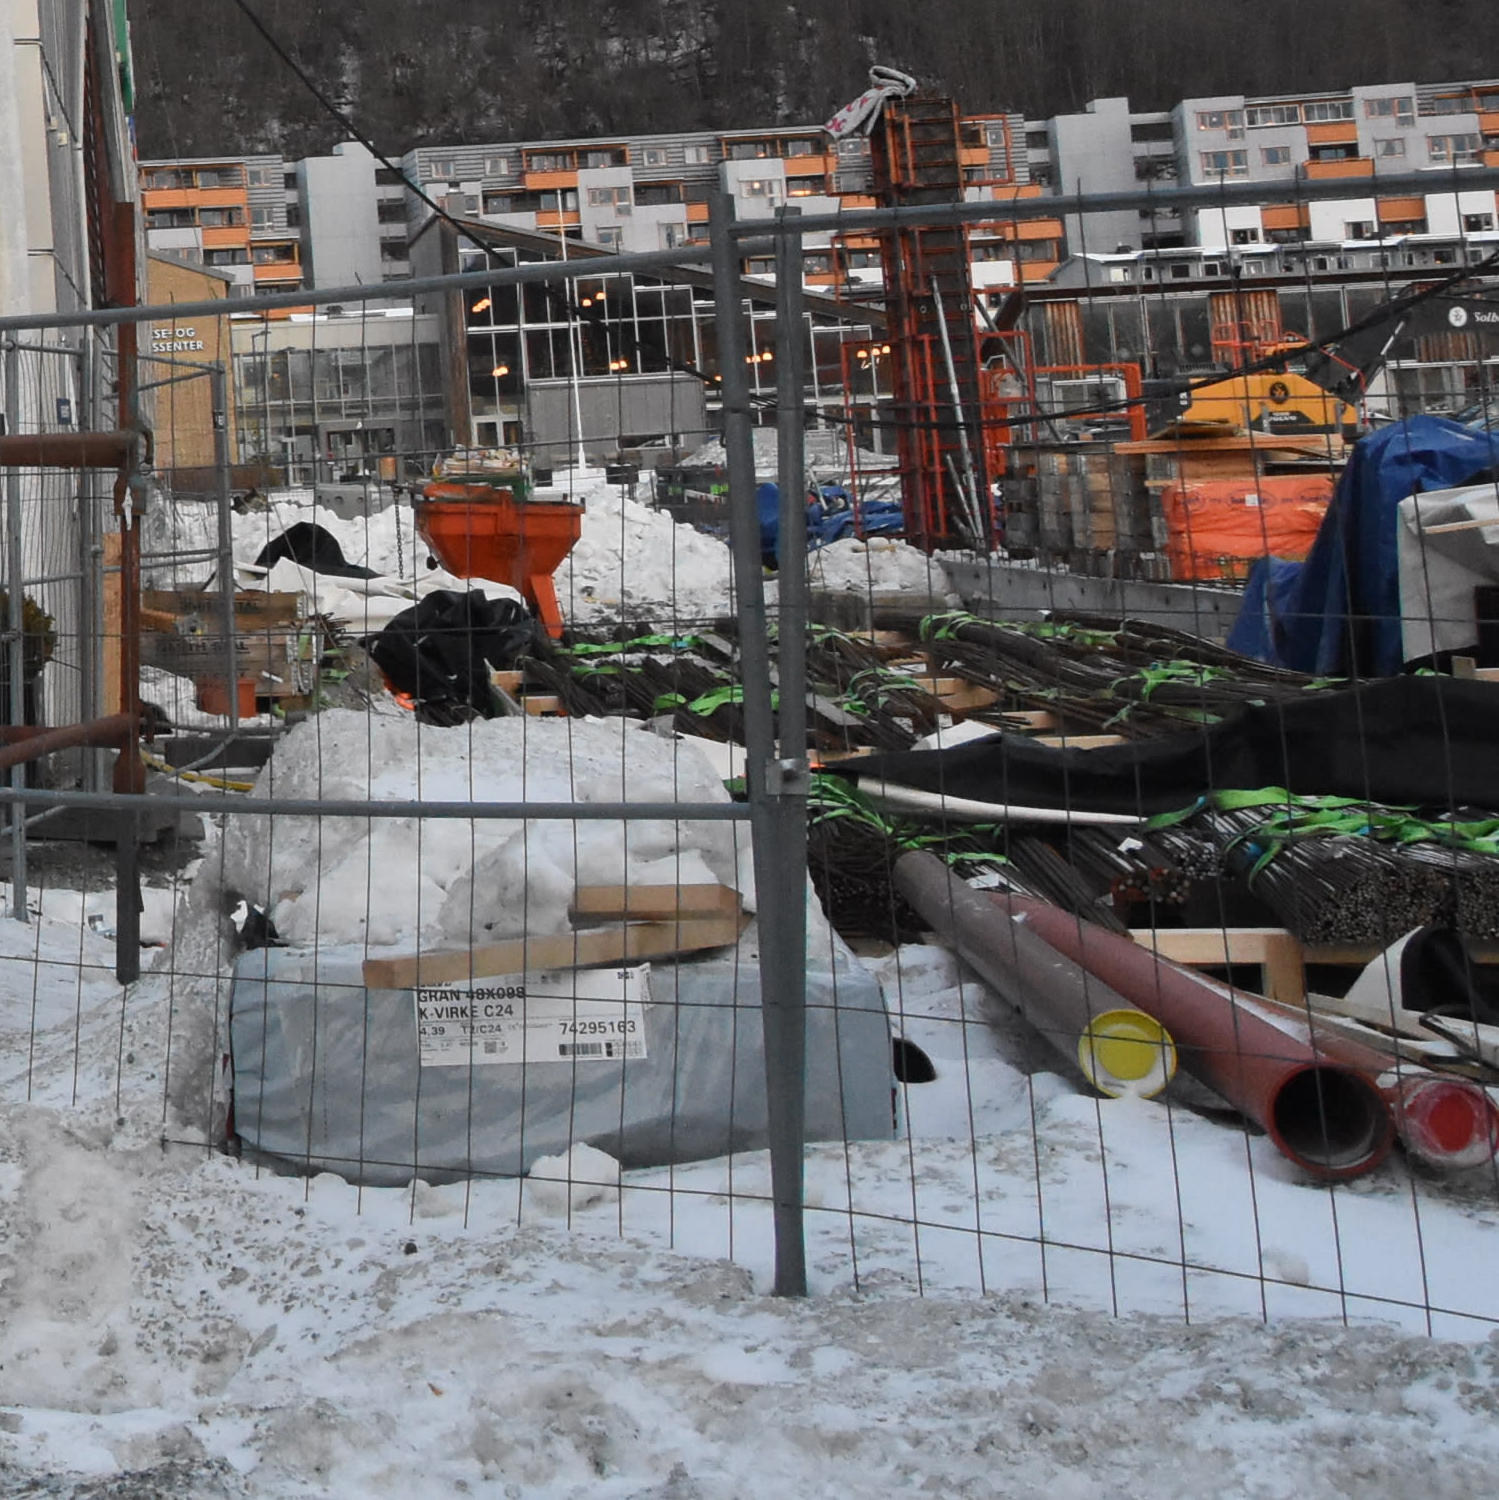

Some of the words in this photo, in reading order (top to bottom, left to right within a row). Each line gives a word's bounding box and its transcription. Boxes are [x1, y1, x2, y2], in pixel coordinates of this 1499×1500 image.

[1474, 311, 1499, 323] Solb
[175, 327, 196, 338] OG
[418, 989, 461, 1003] GRAN
[419, 1005, 479, 1020] K-VIRKE
[484, 1004, 514, 1018] C24
[558, 1020, 636, 1036] 74295163
